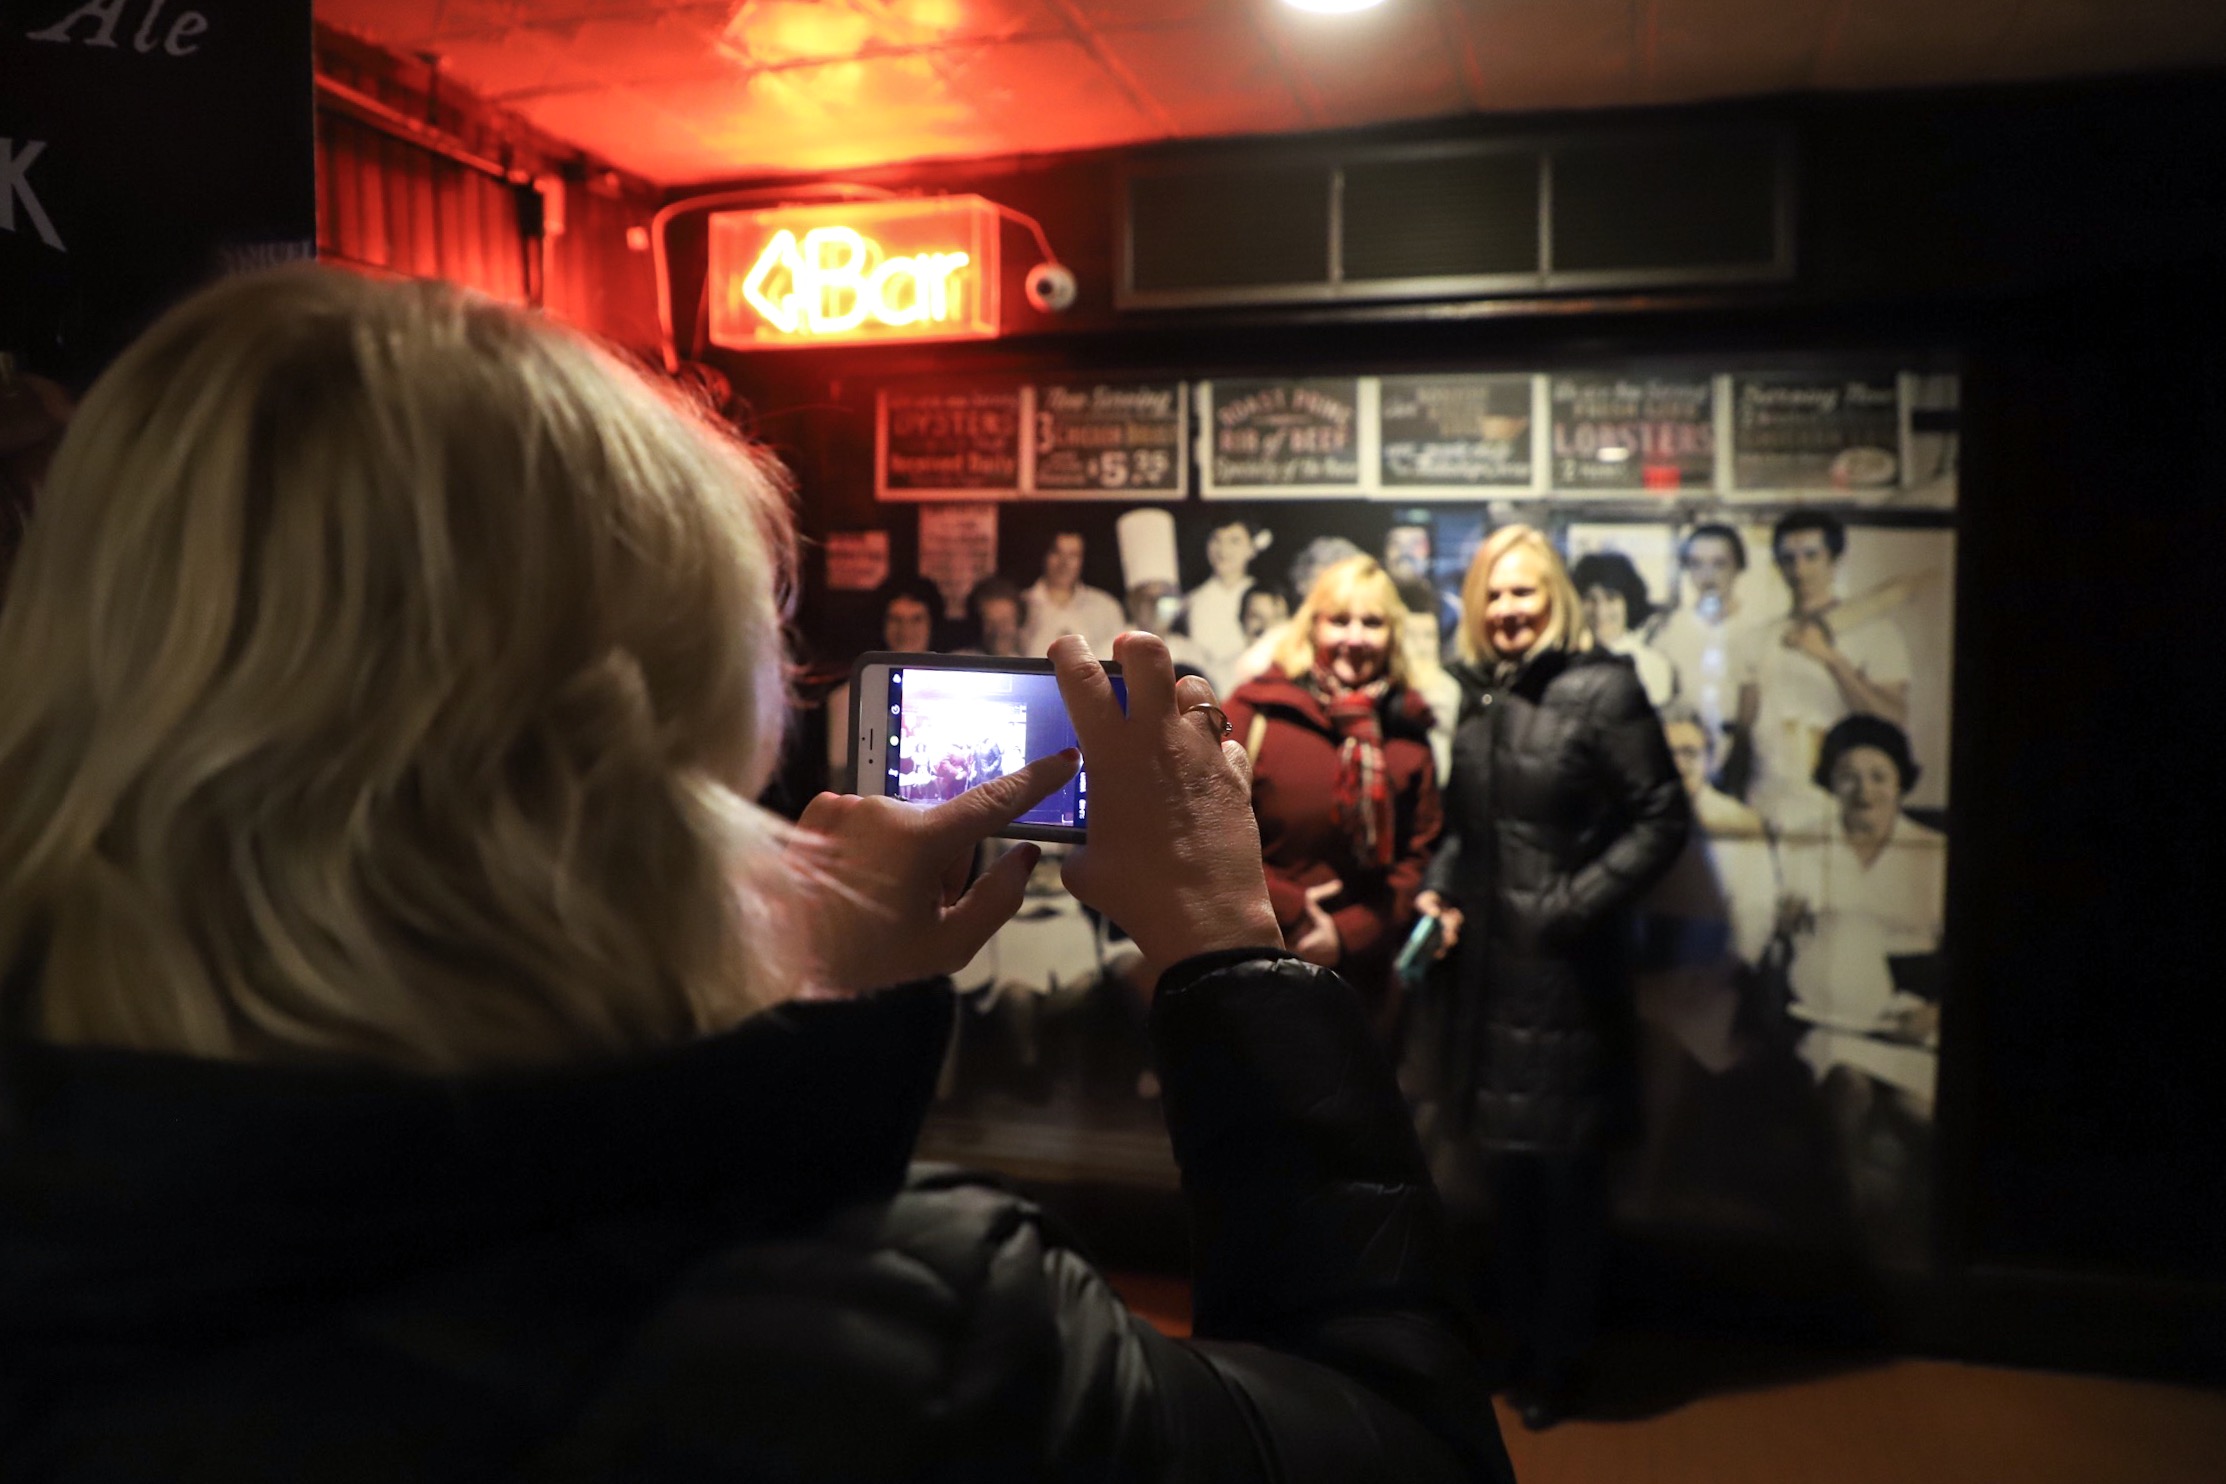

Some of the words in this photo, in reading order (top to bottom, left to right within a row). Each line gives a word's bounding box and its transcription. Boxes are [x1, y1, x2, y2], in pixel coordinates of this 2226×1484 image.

[26, 0, 208, 56] Ale
[802, 226, 970, 334] Bar
[1552, 420, 1714, 458] LOBSTERS
